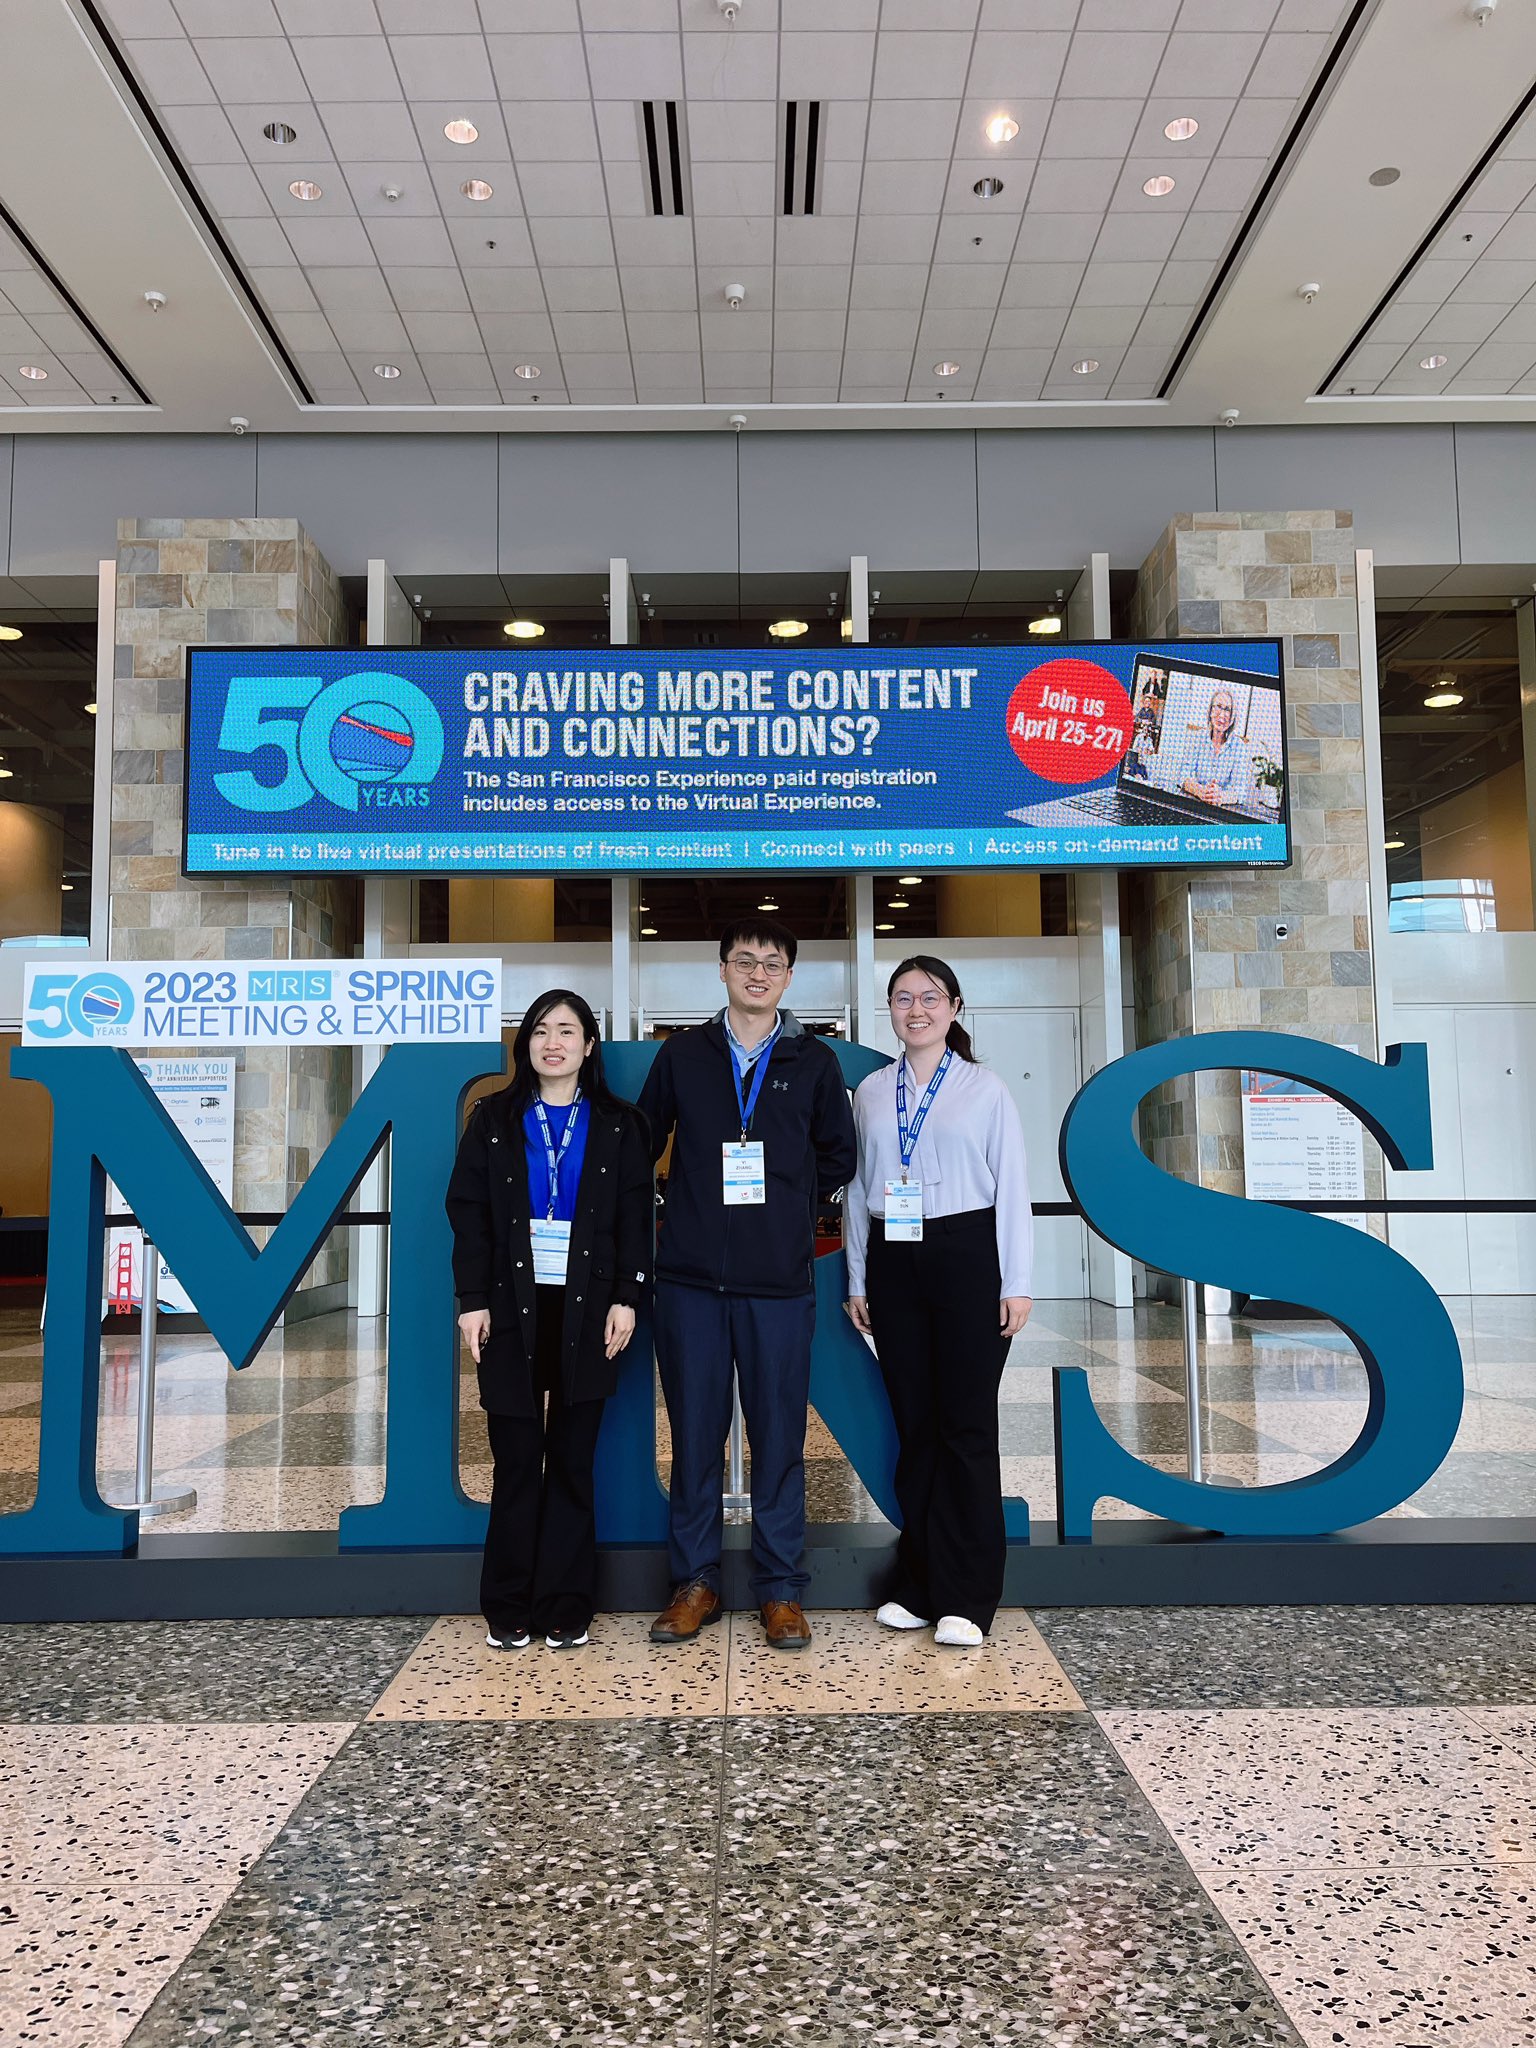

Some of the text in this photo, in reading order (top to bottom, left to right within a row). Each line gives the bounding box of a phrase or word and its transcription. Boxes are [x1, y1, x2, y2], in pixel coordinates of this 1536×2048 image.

[464, 669, 978, 712] CRAVING MORE CONTENT
[1038, 685, 1105, 718] Join us
[213, 671, 445, 812] 50
[463, 716, 880, 758] AND CONNECTIONS?
[1011, 712, 1123, 753] April 25-27!
[463, 769, 937, 790] The San Francisco Experience paid registration
[362, 787, 430, 807] YEARS
[463, 793, 882, 813] includes access to the Virtual Experience.
[212, 841, 733, 862] Tune in to live virtual presentations of fresh content
[761, 839, 955, 858] Connect with peers
[985, 834, 1263, 855] Access on-demand content
[26, 969, 494, 1039] 50 2023 MRS SPRING
[96, 1003, 492, 1037] YEARS MEETING & EXHIBIT
[156, 1063, 228, 1075] THANK YOU
